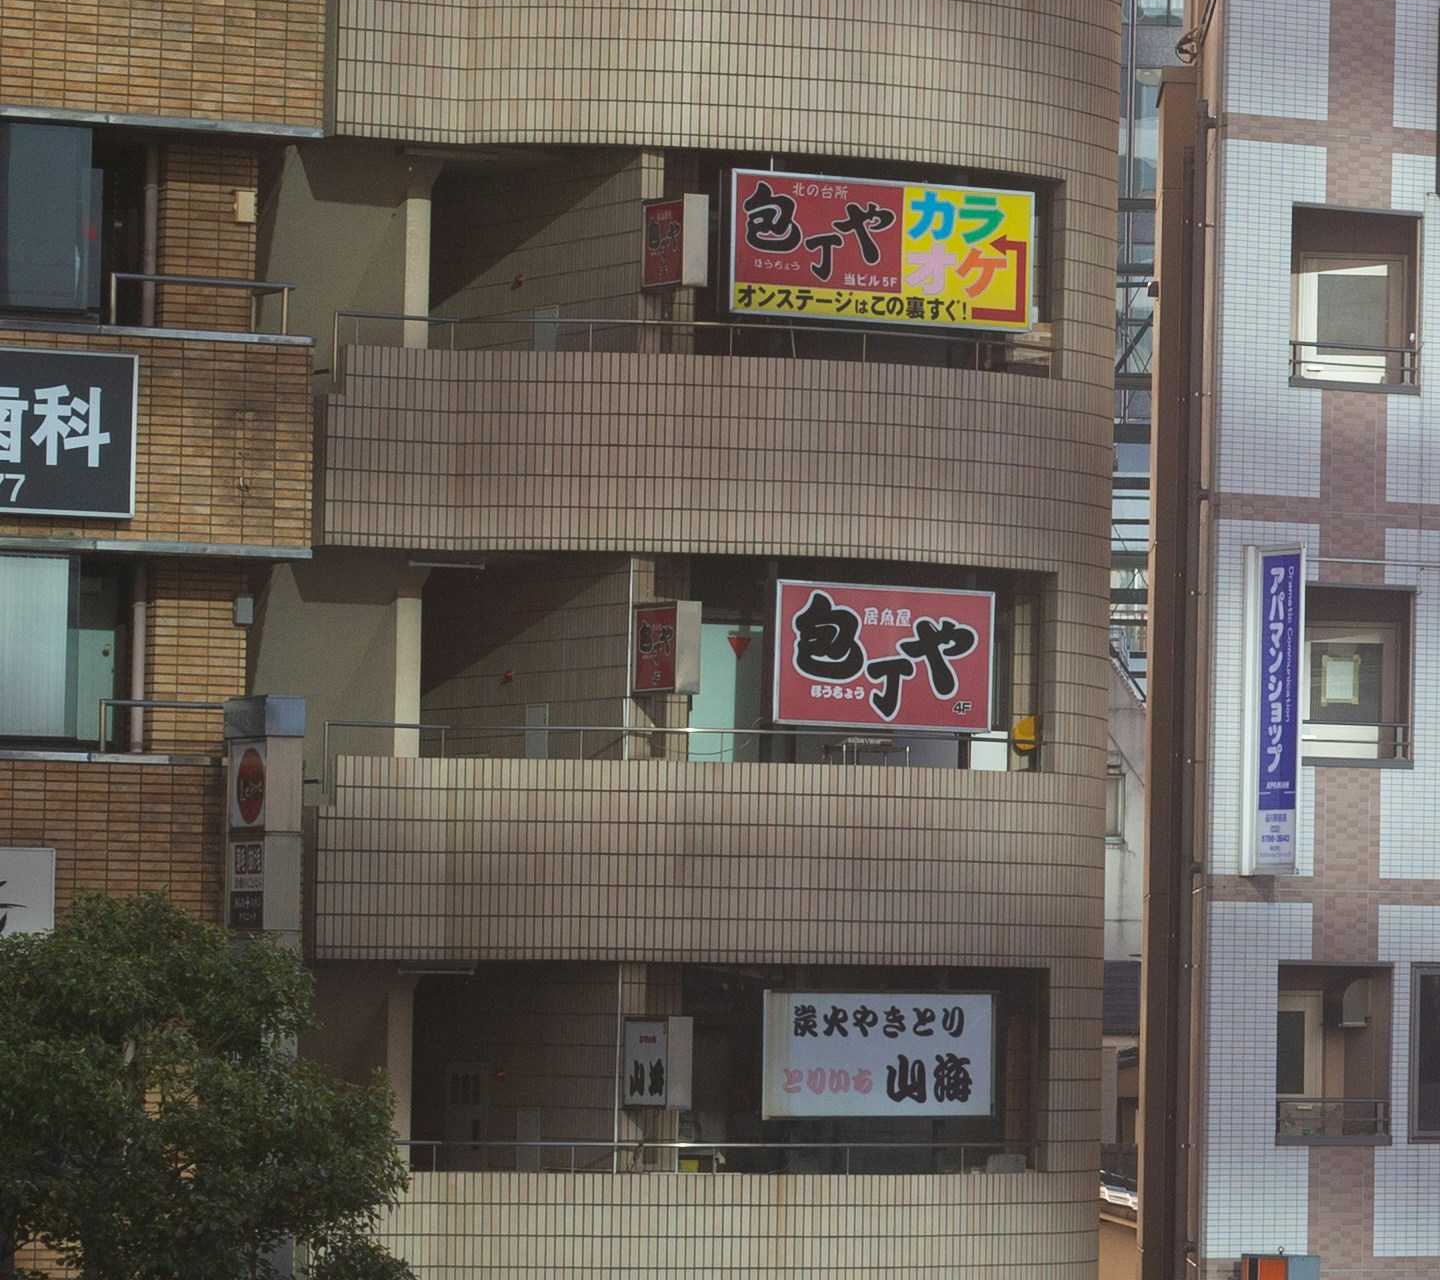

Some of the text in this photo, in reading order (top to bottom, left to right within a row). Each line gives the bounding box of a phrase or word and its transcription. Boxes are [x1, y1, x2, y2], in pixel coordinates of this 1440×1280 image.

[791, 183, 849, 202] 北の台所
[742, 179, 896, 283] 包丁や
[791, 589, 979, 721] 包丁や
[1266, 565, 1286, 774] アパマンショップ
[952, 701, 972, 715] 4F
[793, 1006, 966, 1039] 炭火やきとり
[886, 1052, 973, 1104] 山海
